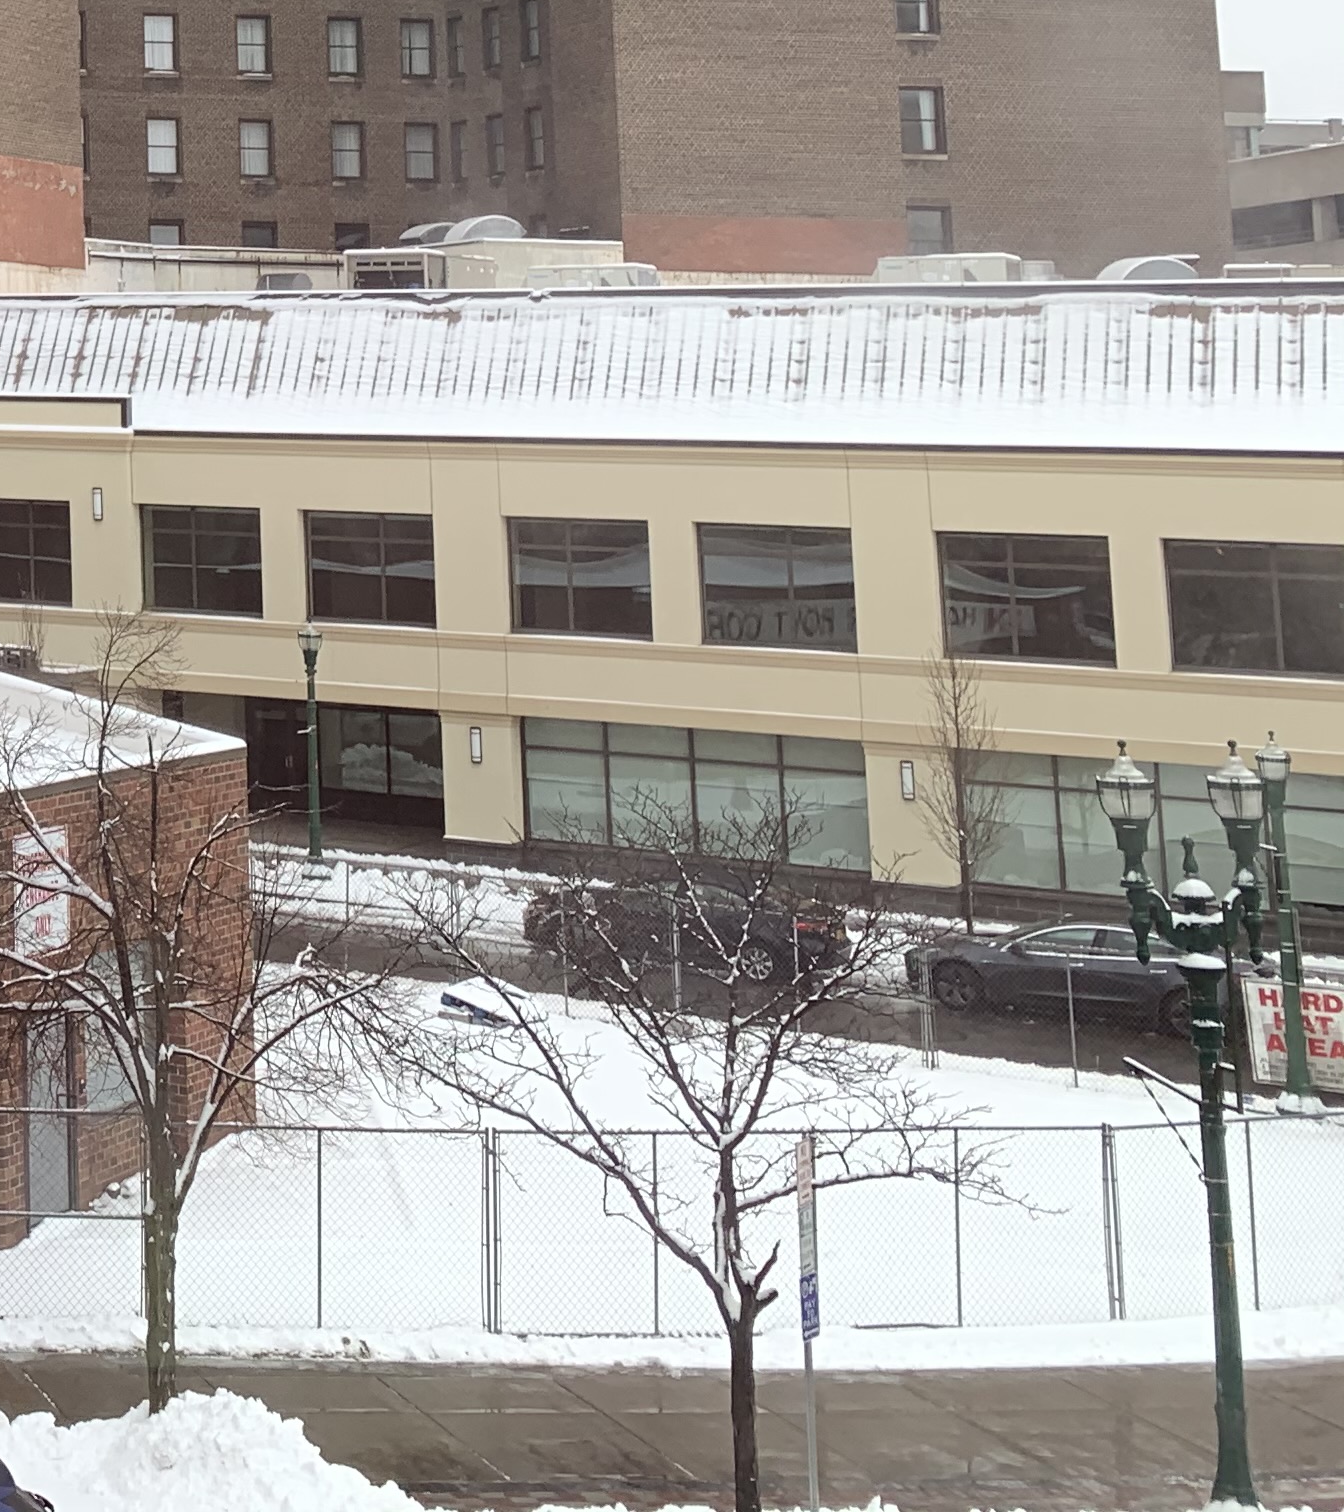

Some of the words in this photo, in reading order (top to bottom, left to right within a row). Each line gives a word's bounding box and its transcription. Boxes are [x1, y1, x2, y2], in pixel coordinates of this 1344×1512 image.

[35, 914, 51, 937] ONLY
[1258, 988, 1343, 1013] HRD
[1267, 1034, 1344, 1058] AEA
